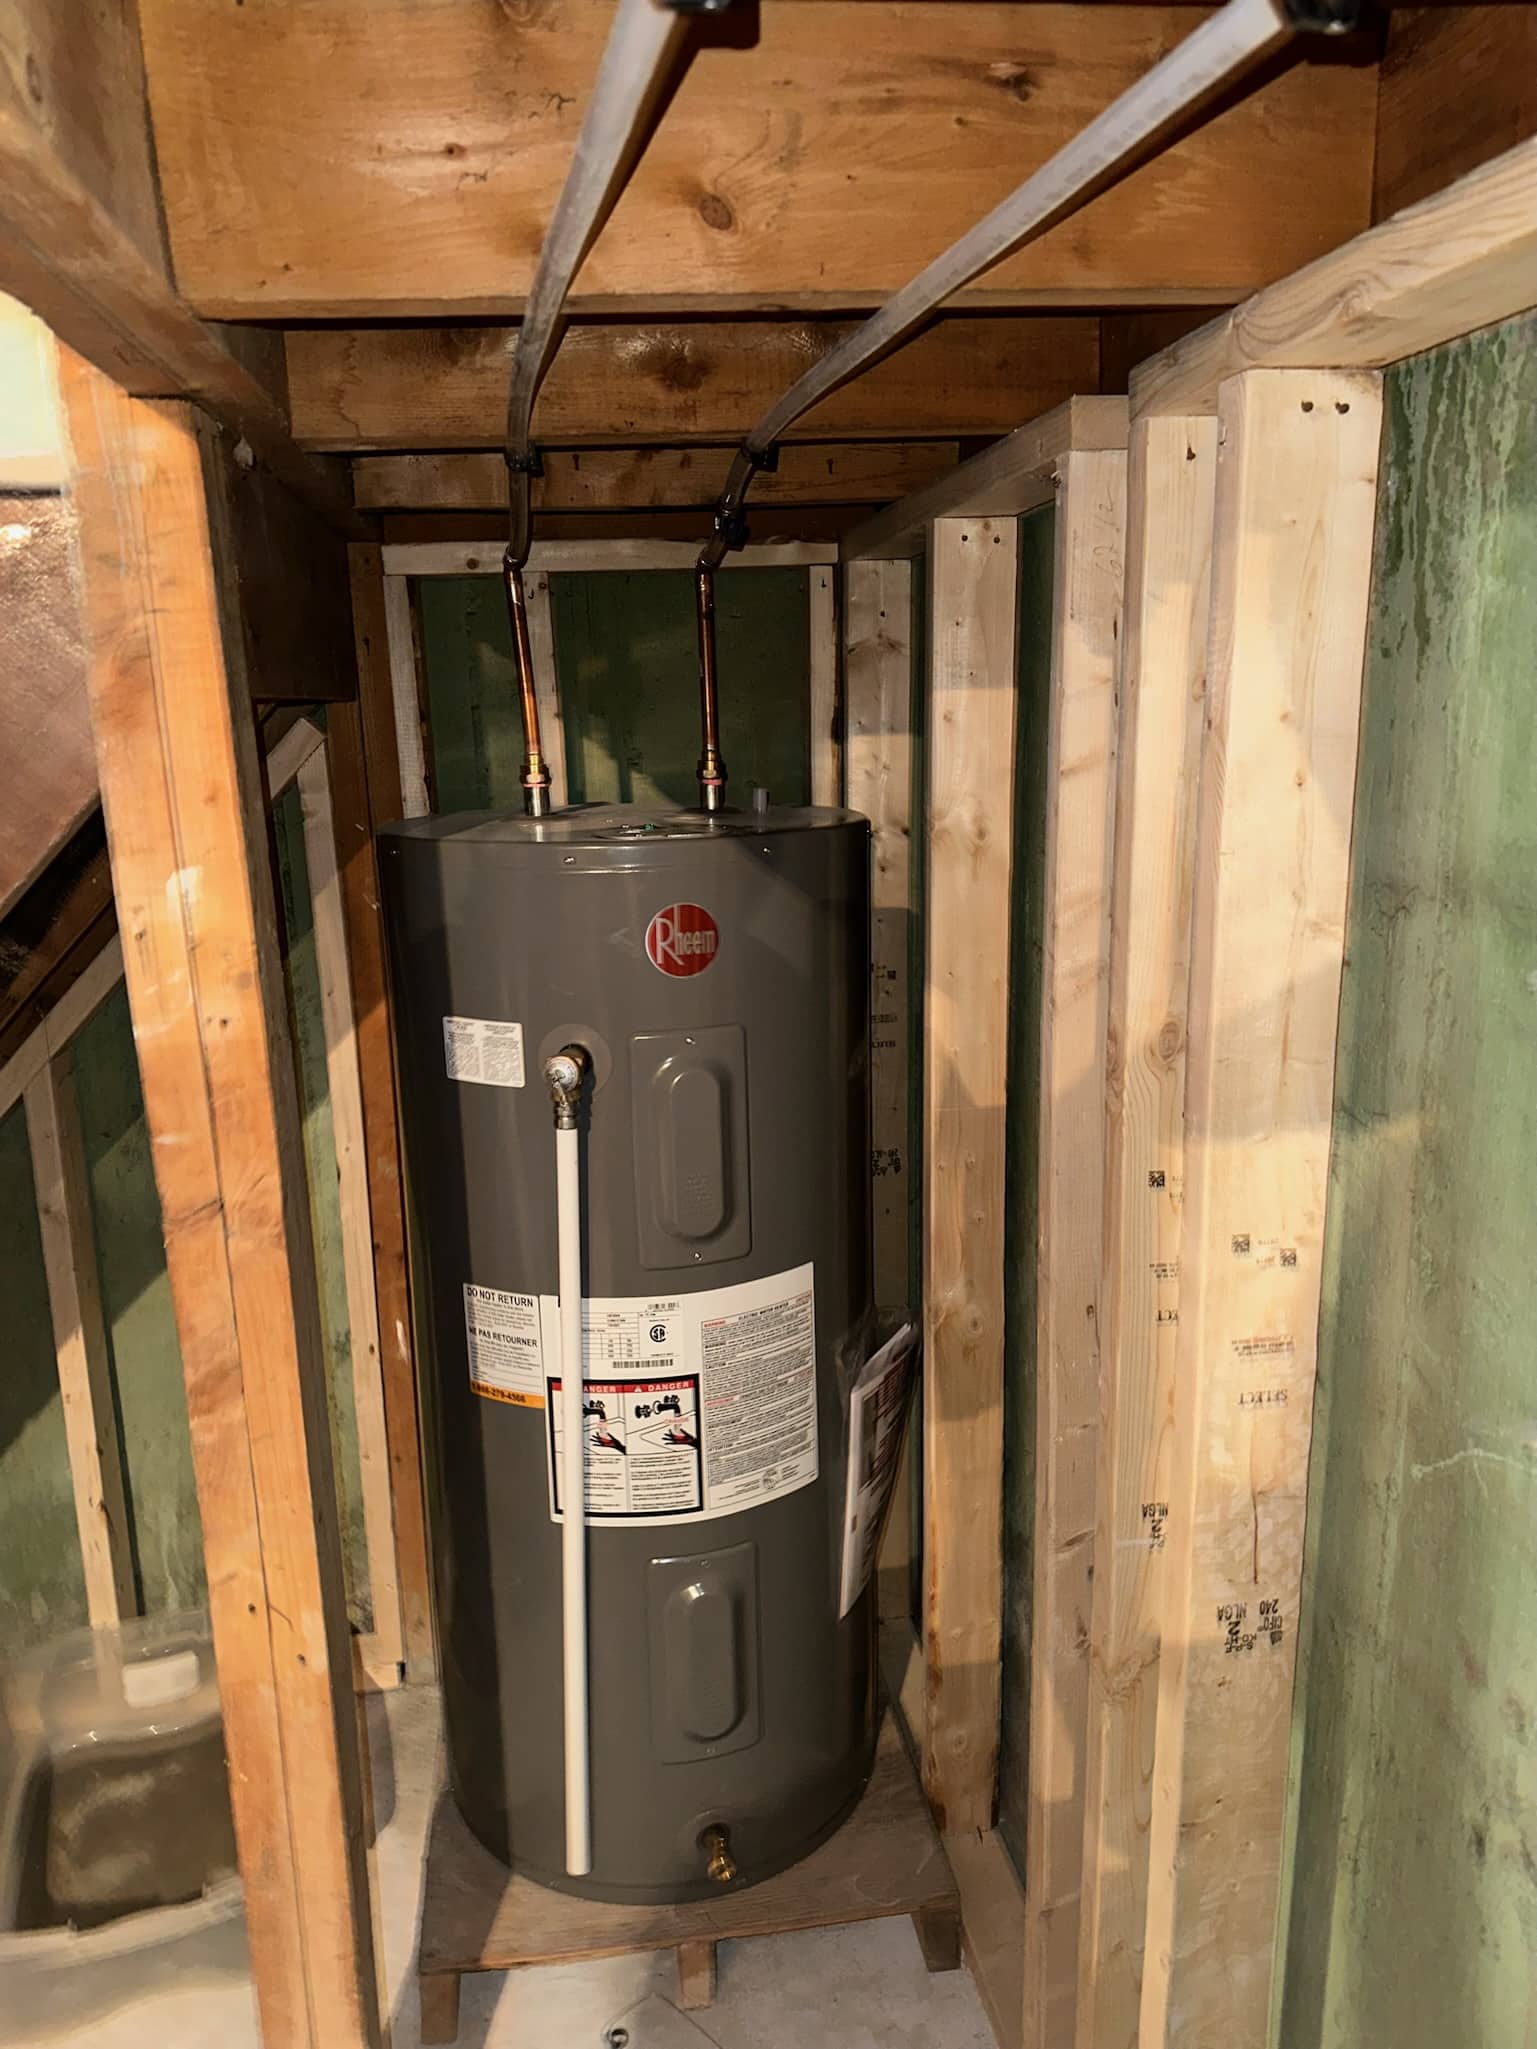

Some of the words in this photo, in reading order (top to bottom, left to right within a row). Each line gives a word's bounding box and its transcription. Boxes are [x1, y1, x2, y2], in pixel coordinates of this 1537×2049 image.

[655, 904, 716, 966] Rheem
[466, 1287, 478, 1298] DO
[479, 1289, 496, 1301] NOT
[498, 1294, 534, 1307] RETURN
[478, 1328, 491, 1339] PAS
[492, 1332, 538, 1347] RETOURNER
[583, 1384, 616, 1393] ANGER
[647, 1381, 689, 1392] DANGER
[1259, 1598, 1279, 1616] 240
[1227, 1620, 1241, 1635] 2
